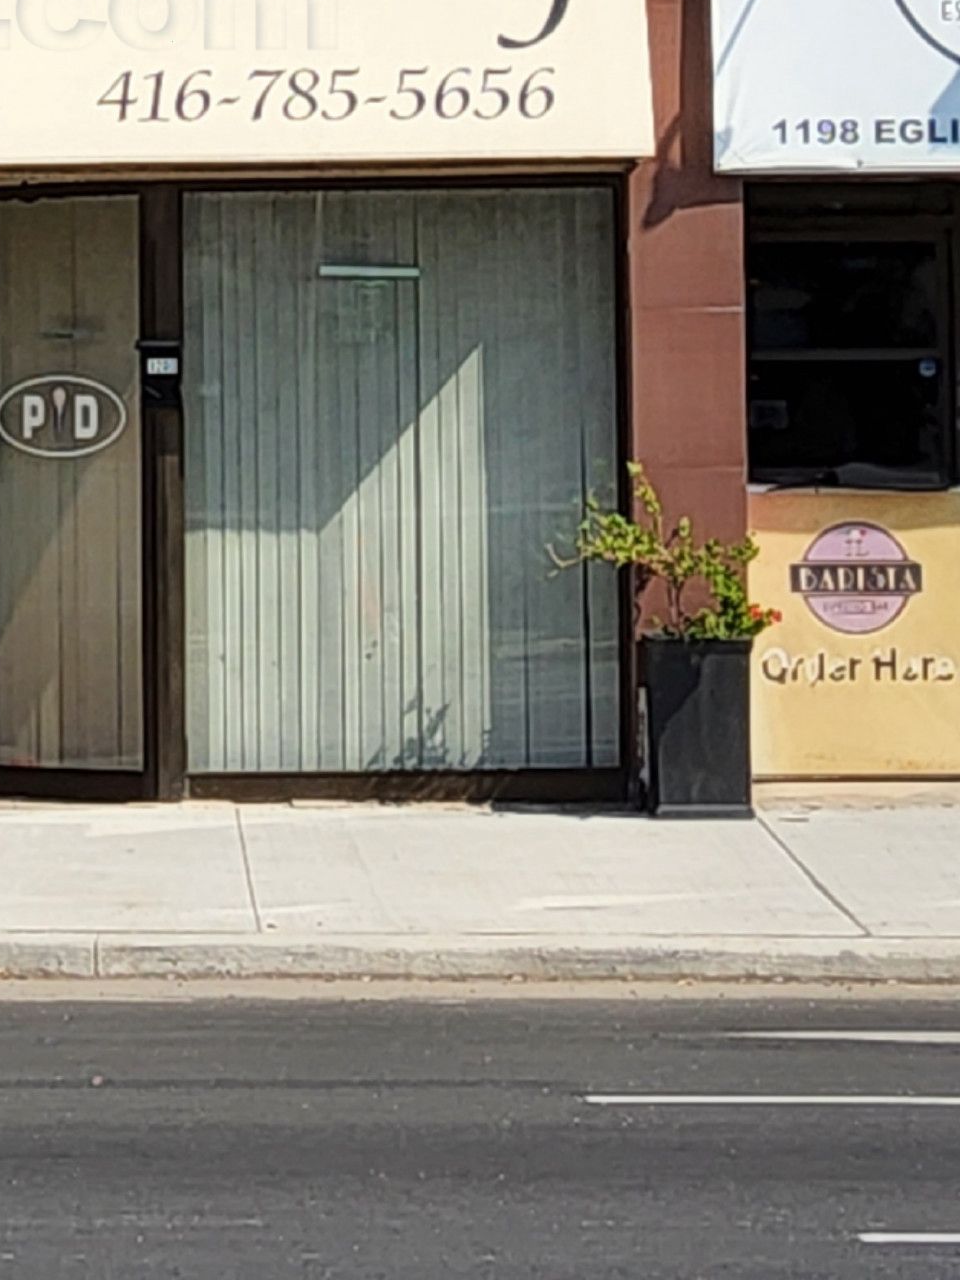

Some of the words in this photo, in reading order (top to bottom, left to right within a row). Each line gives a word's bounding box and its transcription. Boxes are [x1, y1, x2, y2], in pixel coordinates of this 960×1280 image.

[96, 65, 557, 122] 416-785-5656
[772, 119, 859, 144] 1198
[798, 567, 917, 591] BARISTA
